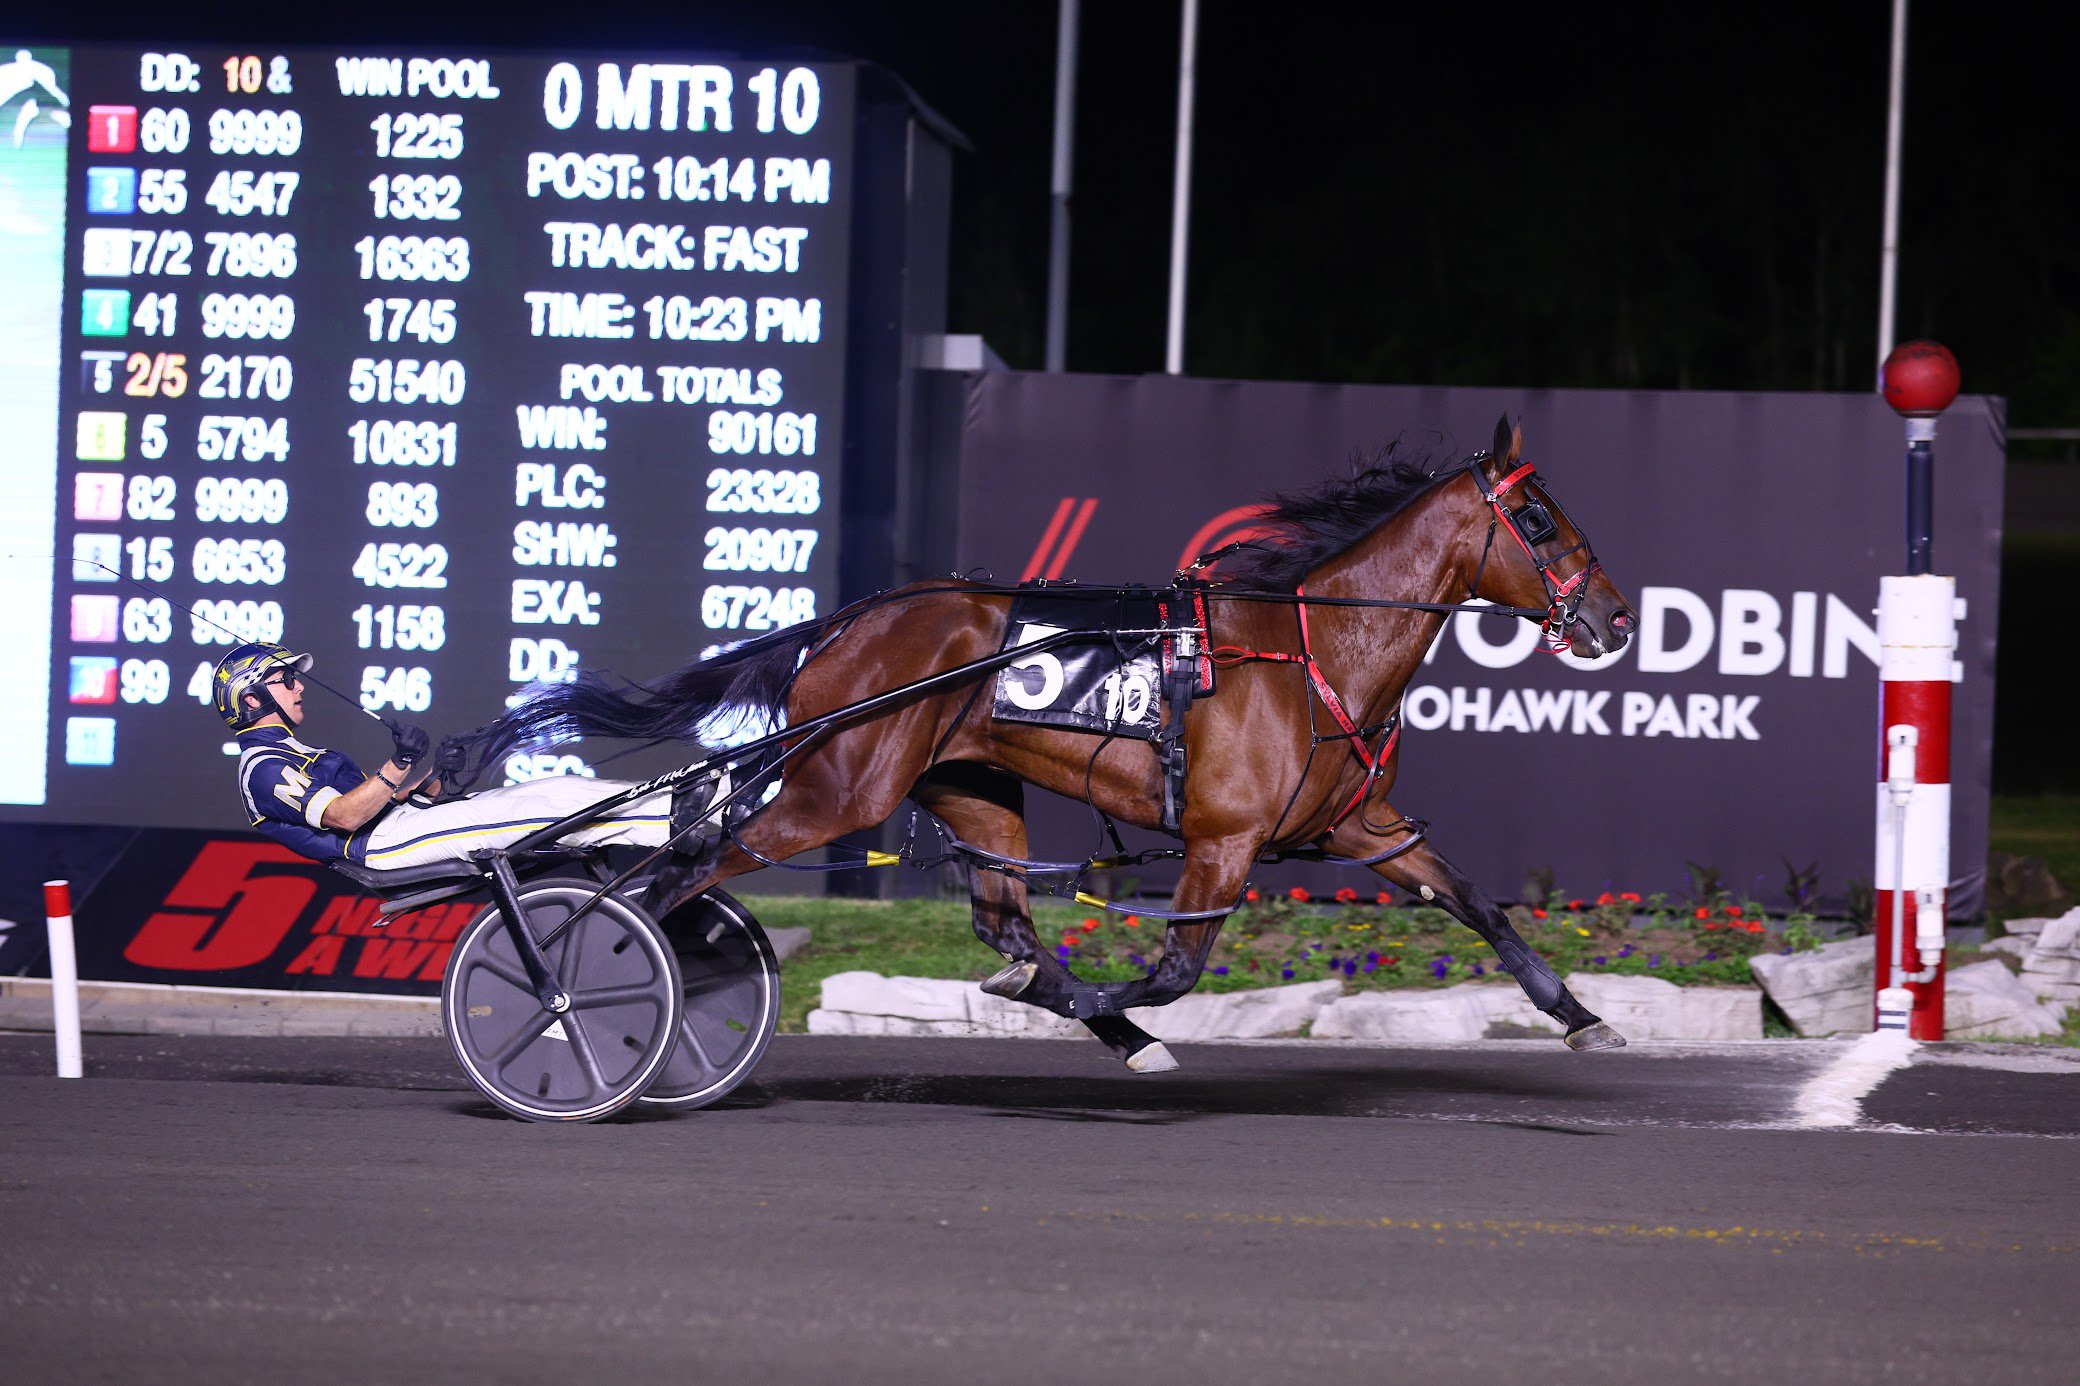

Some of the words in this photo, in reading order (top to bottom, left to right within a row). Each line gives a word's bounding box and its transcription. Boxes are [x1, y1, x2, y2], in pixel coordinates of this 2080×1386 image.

[141, 53, 200, 92] DD:
[224, 56, 261, 92] 10
[267, 56, 292, 93] &
[336, 56, 402, 96] WIN
[408, 58, 500, 98] POOL
[544, 63, 582, 129] 0
[596, 63, 733, 132] MTR
[748, 67, 820, 134] 10
[107, 115, 120, 147] 1
[141, 108, 190, 153] 60
[209, 109, 302, 155] 9999
[371, 113, 463, 159] 1225
[138, 169, 187, 214] 55
[205, 171, 299, 216] 4547
[369, 174, 462, 220] 1332
[527, 152, 644, 200] POST:
[653, 156, 756, 202] 10:14
[764, 158, 830, 203] PM
[132, 229, 193, 275] 7/2
[205, 232, 297, 277] 7896
[355, 236, 470, 281] 16363
[544, 222, 695, 270] TRACK:
[704, 226, 808, 272] FAST
[133, 293, 177, 336] 41
[202, 293, 295, 339] 9999
[364, 298, 456, 343] 1745
[524, 292, 635, 338] TIME:
[643, 296, 748, 341] 10:23
[755, 297, 821, 343] PM
[94, 359, 113, 393] 5
[125, 353, 187, 397] 2/5
[199, 354, 293, 401] 2170
[349, 358, 466, 405] 51540
[561, 364, 653, 402] POOL
[657, 366, 783, 406] TOTALS
[141, 414, 168, 459] 5
[198, 416, 290, 461] 5794
[348, 420, 456, 466] 10831
[516, 405, 607, 450] WIN:
[708, 410, 816, 455] 90161
[127, 475, 176, 520] 82
[195, 477, 288, 523] 9999
[366, 482, 438, 527] 893
[516, 463, 605, 509] PLC:
[706, 468, 820, 514] 23328
[126, 537, 174, 582] 15
[192, 538, 286, 585] 6653
[352, 543, 448, 588] 4522
[512, 521, 617, 566] SHW:
[703, 527, 818, 572] 20907
[123, 598, 172, 643] 63
[190, 599, 284, 645] 9999
[352, 604, 445, 651] 1158
[512, 579, 601, 625] EXA:
[700, 585, 816, 630] 67248
[121, 659, 170, 704] 99
[360, 666, 431, 711] 546
[509, 638, 579, 684] DD:
[1005, 623, 1069, 710] 5
[1104, 672, 1151, 724] 10
[1400, 685, 1611, 736] OHAWK
[1622, 692, 1762, 740] PARK
[273, 765, 312, 812] M
[124, 840, 318, 970] 5
[285, 935, 346, 976] A
